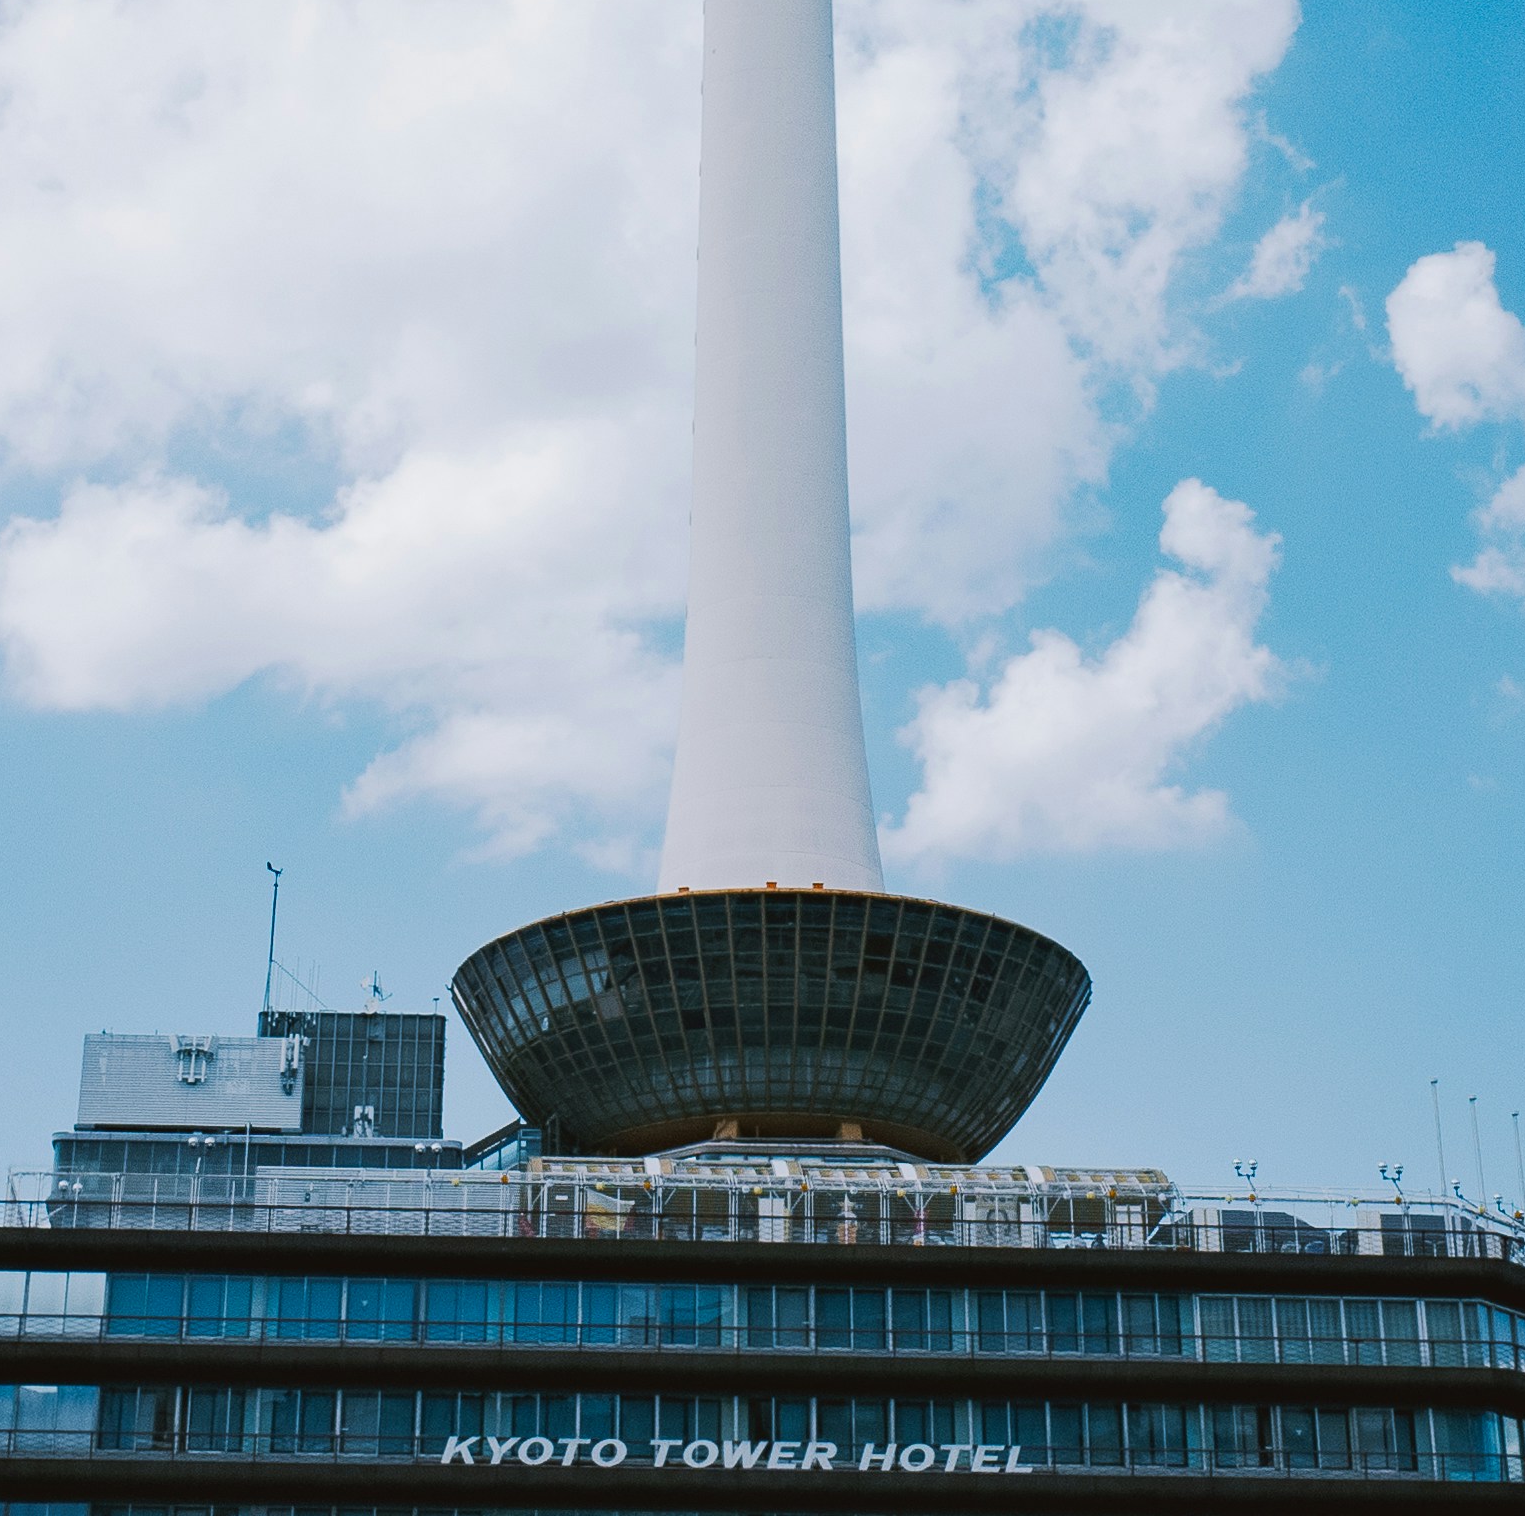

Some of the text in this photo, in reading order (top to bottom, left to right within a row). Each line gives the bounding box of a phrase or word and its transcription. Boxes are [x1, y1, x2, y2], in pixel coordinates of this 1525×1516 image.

[440, 1435, 1034, 1474] KYOTO TOWER HOTEL
